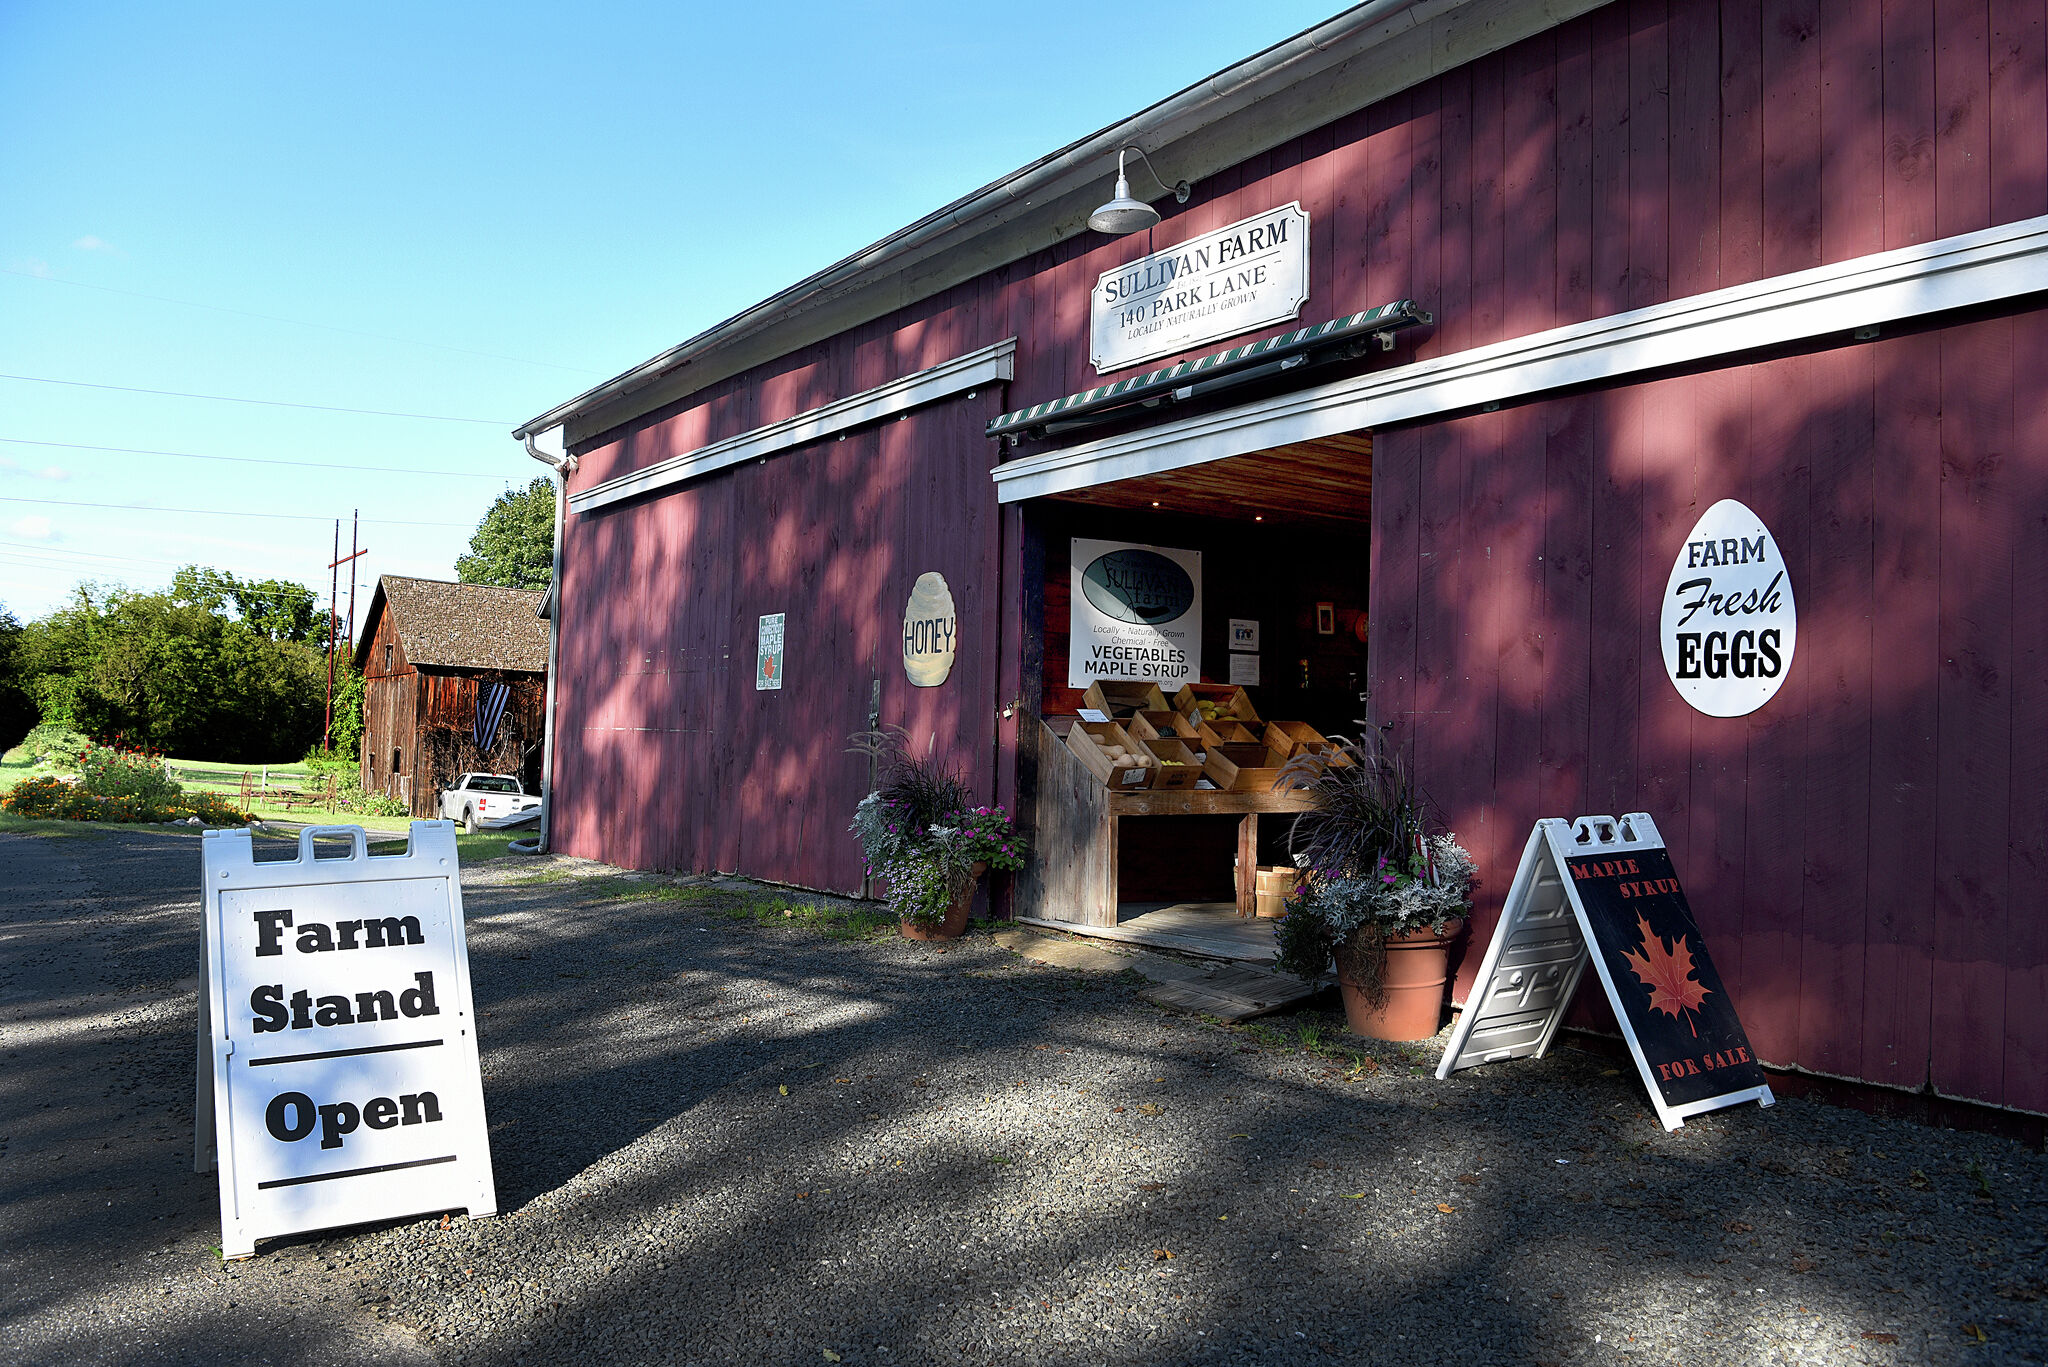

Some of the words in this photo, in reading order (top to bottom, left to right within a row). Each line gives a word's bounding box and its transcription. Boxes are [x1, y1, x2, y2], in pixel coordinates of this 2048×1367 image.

[1105, 245, 1212, 303] SULLIVAN
[1217, 217, 1289, 265] FARM
[1120, 305, 1145, 328] 140
[1151, 287, 1203, 318] PARK
[1209, 265, 1267, 299] LANE
[1128, 319, 1165, 340] LOCALLY
[1166, 302, 1218, 328] NATURALLY
[1220, 290, 1258, 311] GROWN
[1687, 535, 1766, 568] FARM
[1675, 570, 1784, 627] Fresh
[761, 634, 782, 646] MAPLE
[1093, 625, 1120, 635] Locally
[1128, 627, 1160, 638] Naturally
[1162, 629, 1185, 638] Grown
[1111, 636, 1146, 645] Chemical
[1153, 638, 1169, 647] Free
[760, 644, 782, 656] SYRUP
[1091, 645, 1186, 663] VEGETABLES
[1675, 628, 1782, 679] EGGS
[1084, 660, 1137, 676] MAPLE
[1142, 663, 1189, 678] SYRUP
[1570, 859, 1640, 880] MAPLE
[1620, 877, 1681, 899] SYRUP
[253, 909, 425, 957] Farm
[250, 971, 440, 1034] Stand
[1657, 1058, 1701, 1081] FOR
[1703, 1046, 1751, 1072] SALE
[264, 1089, 443, 1150] Open
